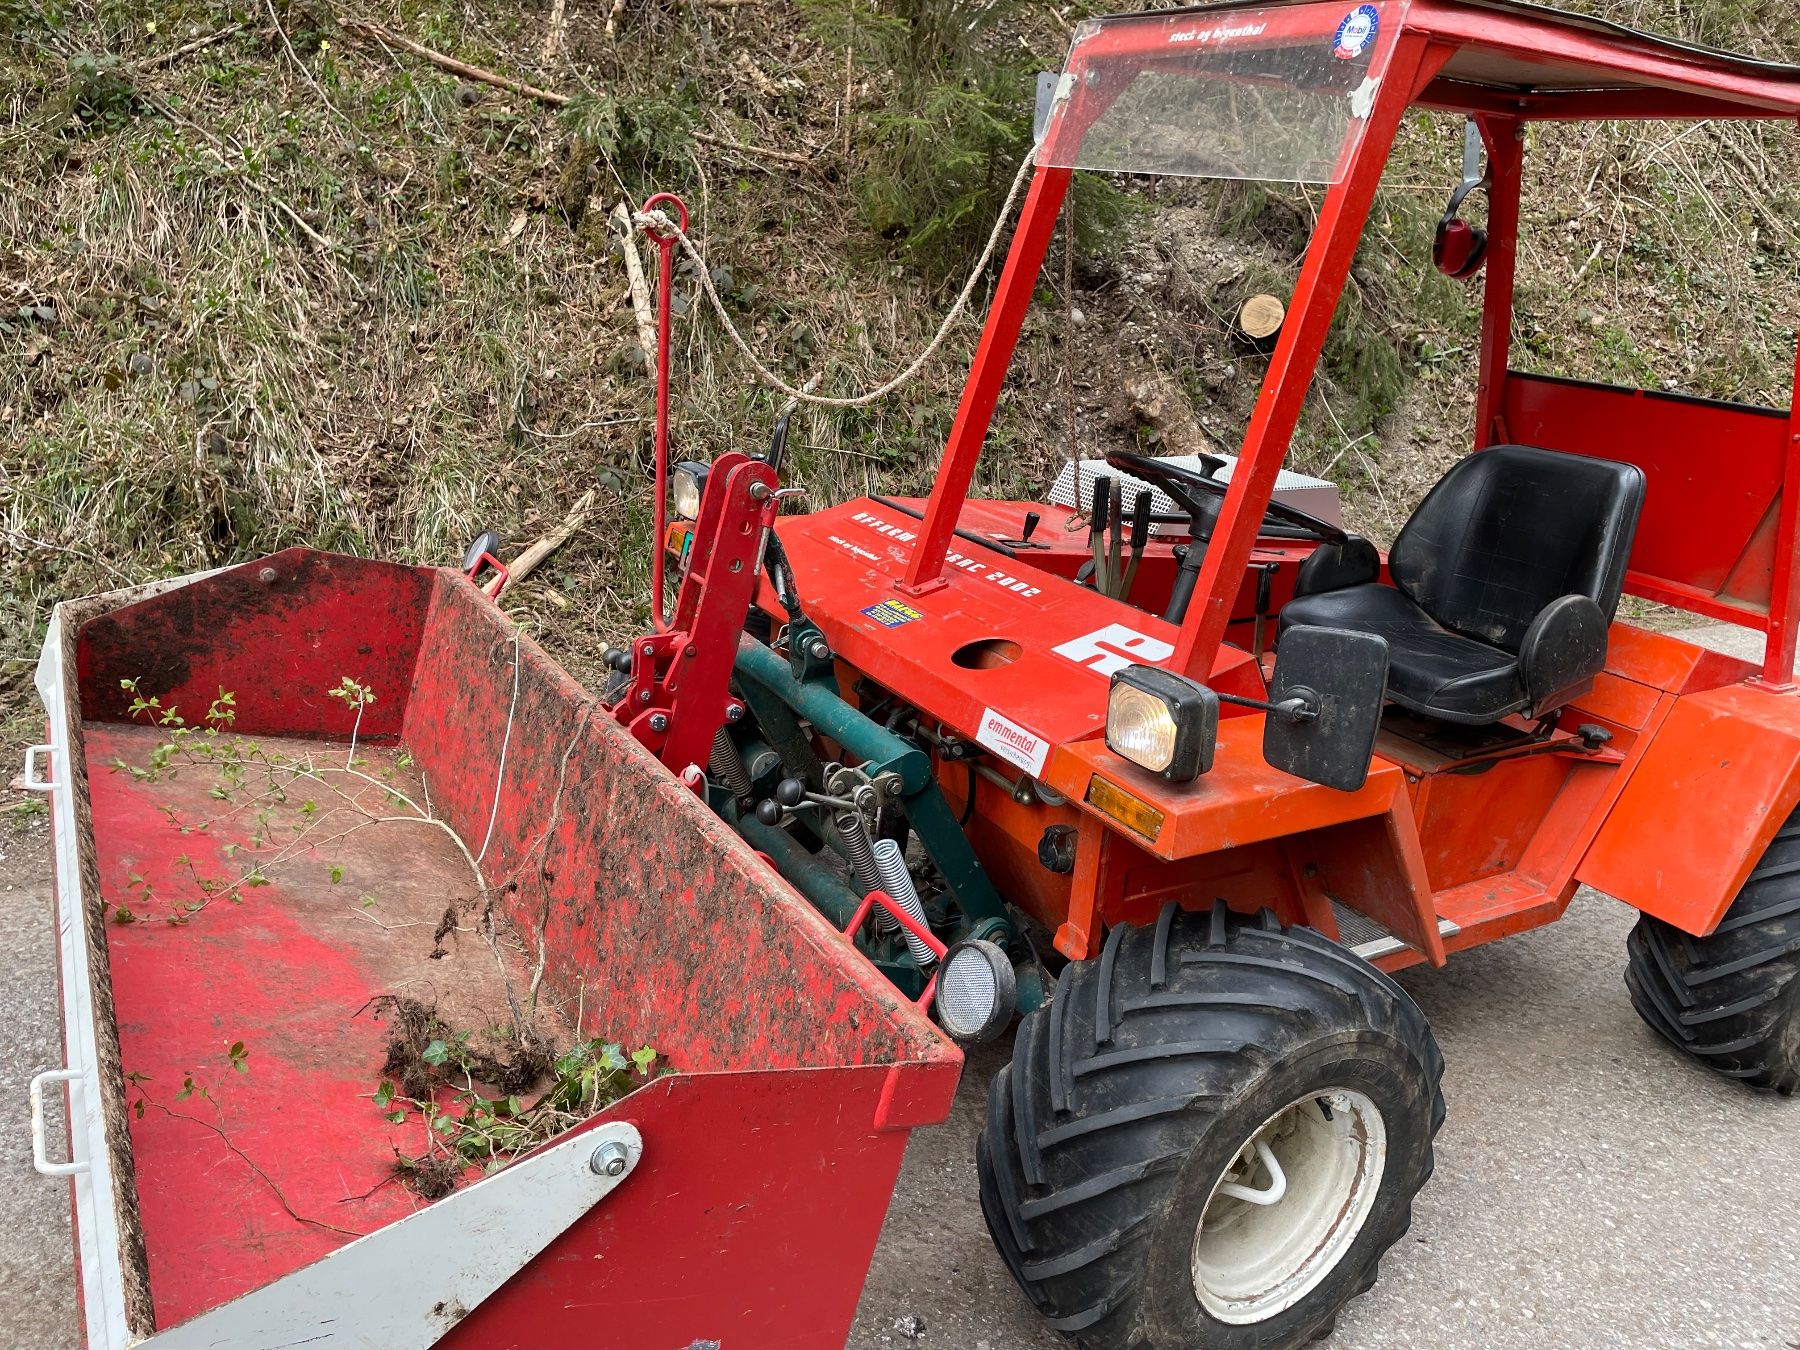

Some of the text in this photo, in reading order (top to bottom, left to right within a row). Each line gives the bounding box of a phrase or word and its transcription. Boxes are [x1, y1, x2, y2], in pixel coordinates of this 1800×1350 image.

[1346, 25, 1368, 34] Mobil
[984, 571, 1042, 597] 2002
[987, 718, 1038, 754] emmental
